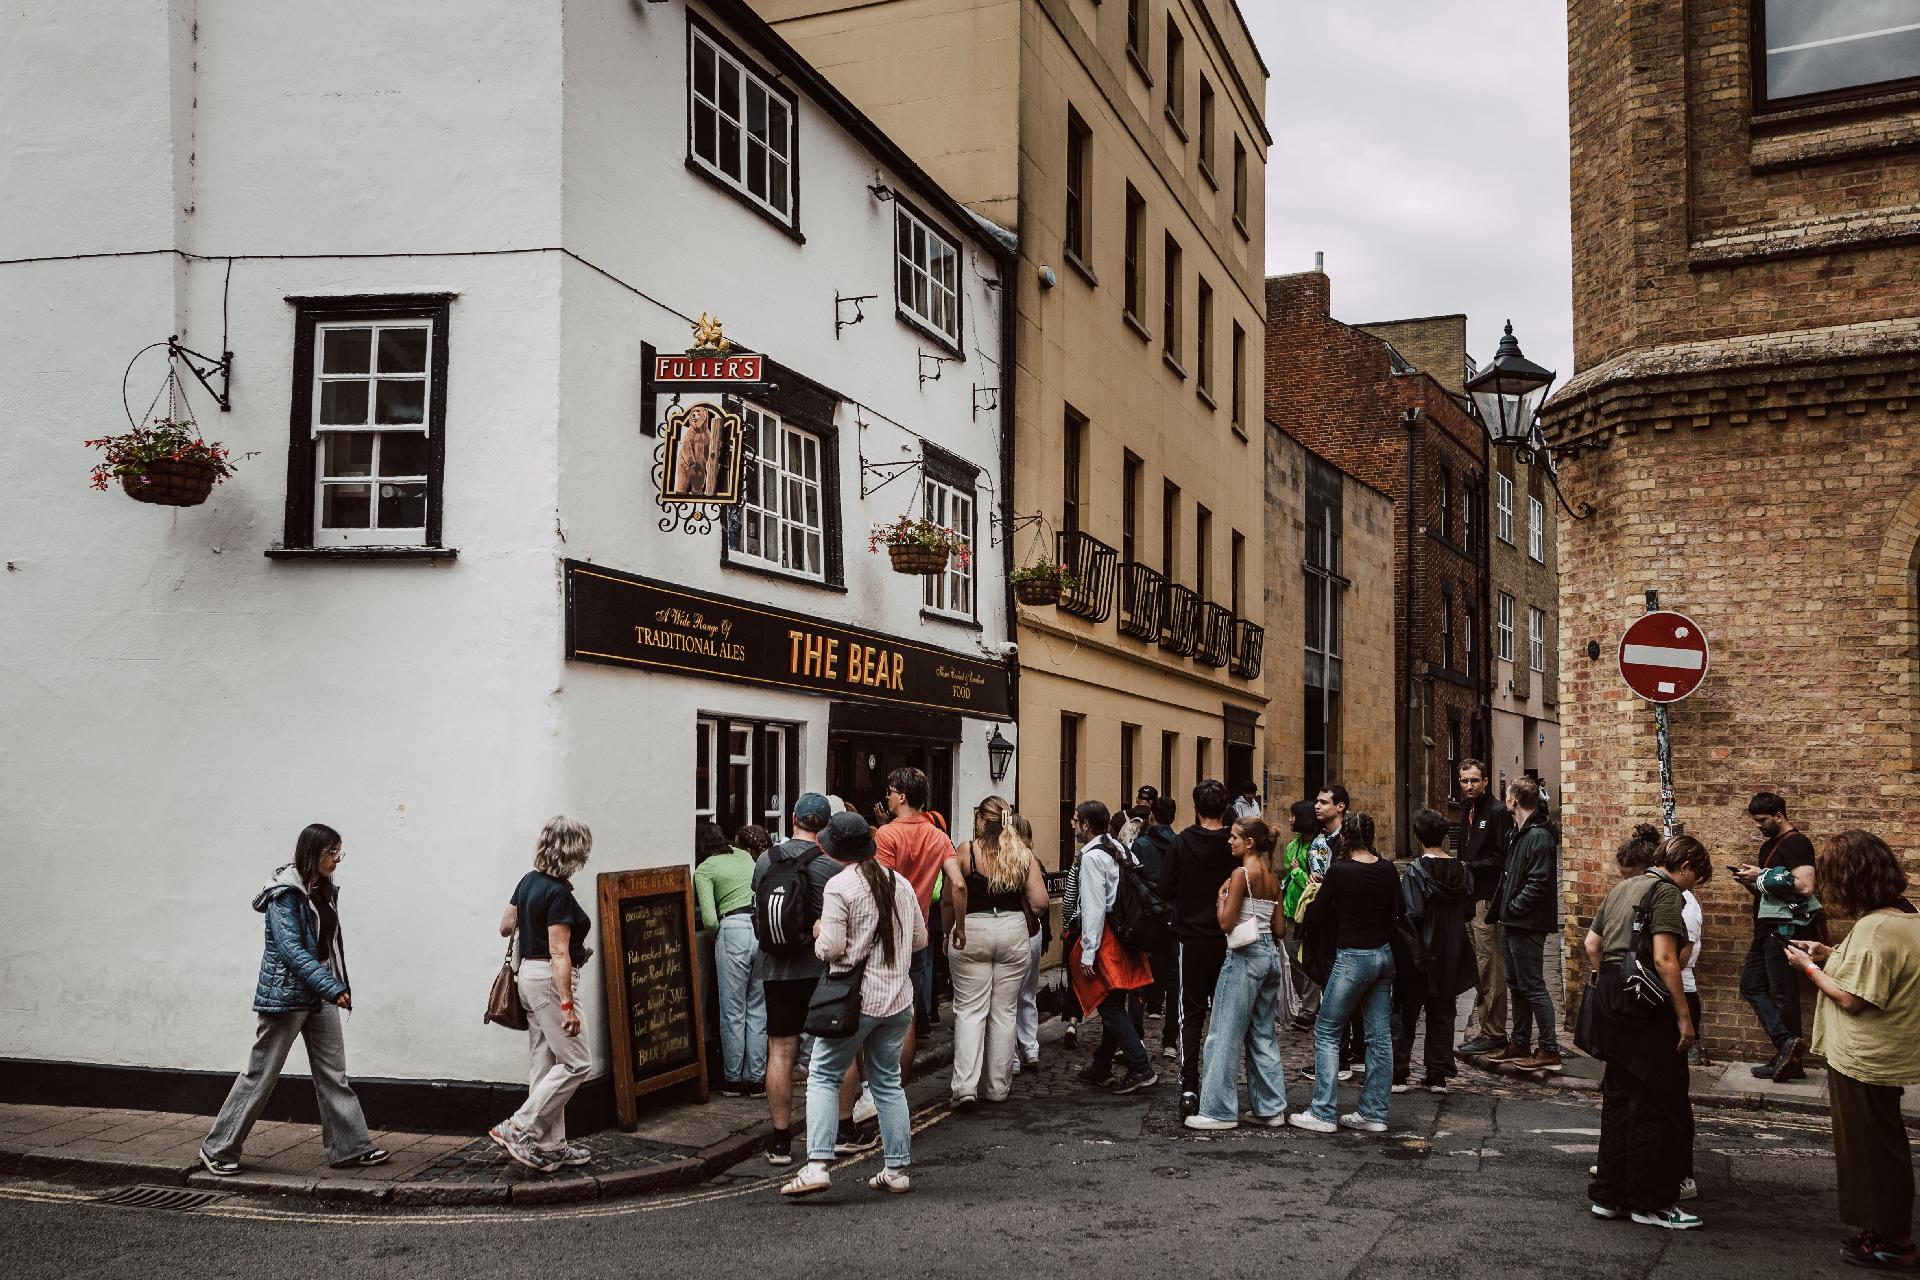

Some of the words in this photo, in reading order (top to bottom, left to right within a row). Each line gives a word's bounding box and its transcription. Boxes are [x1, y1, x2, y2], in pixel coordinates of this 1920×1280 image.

[660, 358, 754, 379] FULLER'S
[671, 608, 691, 628] Wide
[692, 612, 719, 638] Range
[721, 618, 733, 641] Of
[635, 626, 718, 657] TRADITIONAL
[719, 642, 745, 662] ALES
[787, 630, 839, 680] THE
[846, 642, 904, 692] BEAR
[952, 684, 971, 699] FOOD
[630, 876, 648, 890] THE
[651, 873, 674, 888] BEAR
[627, 950, 640, 965] Pub
[640, 944, 662, 962] cooked
[631, 971, 648, 987] Fine
[649, 962, 664, 980] Real
[667, 960, 681, 976] Ales
[638, 1046, 659, 1066] BEER
[660, 1033, 689, 1060] GARDEN
